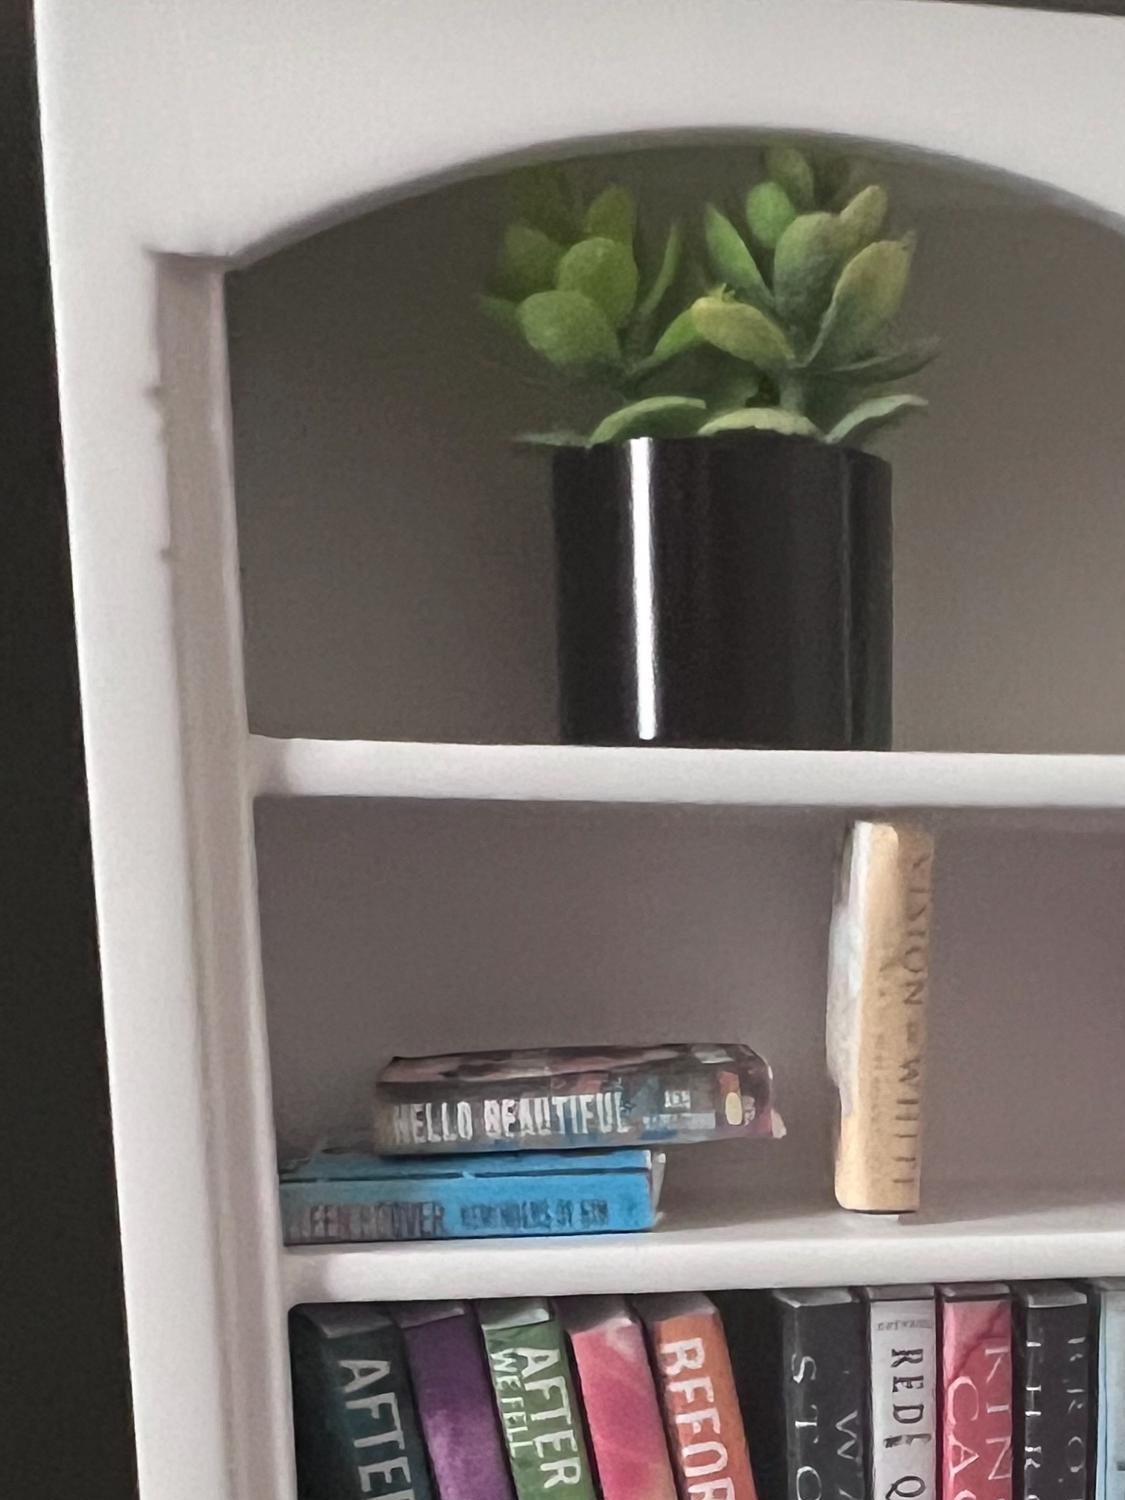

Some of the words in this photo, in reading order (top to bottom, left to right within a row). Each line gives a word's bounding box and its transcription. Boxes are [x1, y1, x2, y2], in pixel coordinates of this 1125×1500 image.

[394, 1101, 474, 1145] HELLO
[483, 1091, 632, 1138] BEAUTIFUL
[488, 1348, 522, 1393] WE
[890, 1347, 925, 1435] RED
[500, 1394, 534, 1458] FELL
[515, 1346, 582, 1489] AFTER
